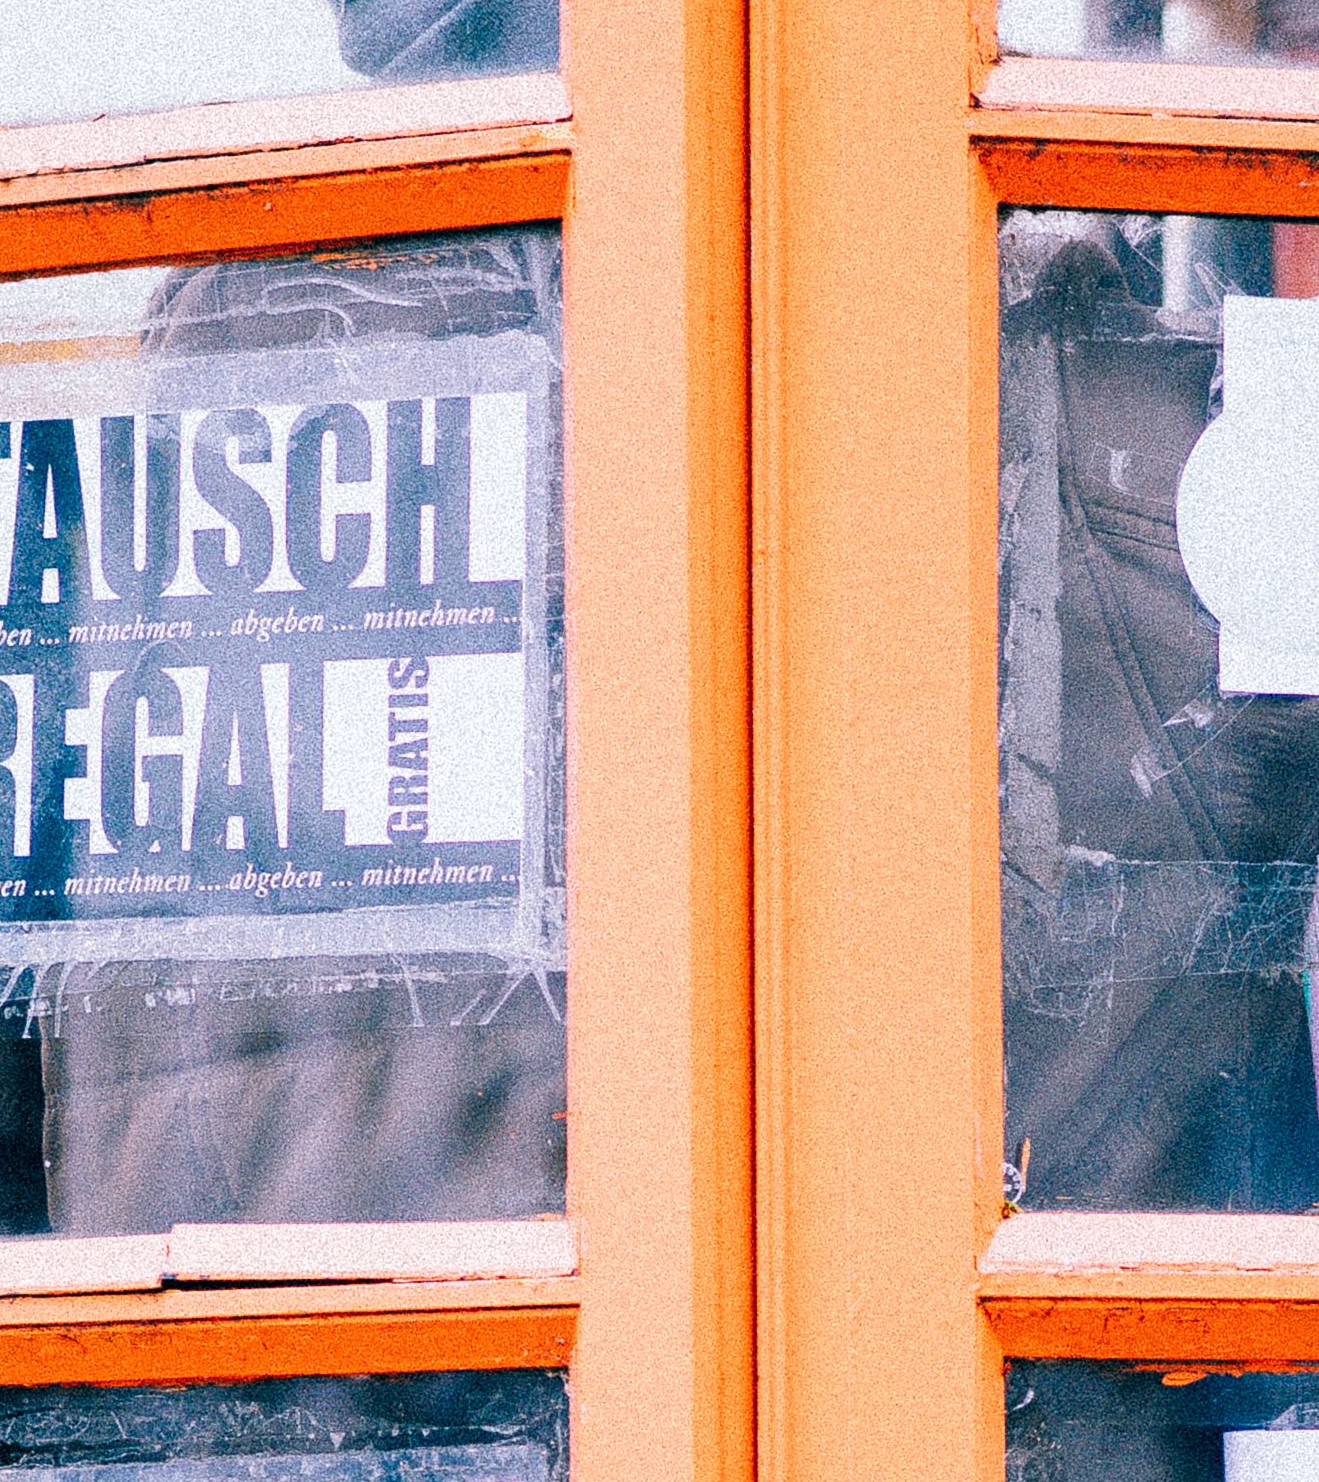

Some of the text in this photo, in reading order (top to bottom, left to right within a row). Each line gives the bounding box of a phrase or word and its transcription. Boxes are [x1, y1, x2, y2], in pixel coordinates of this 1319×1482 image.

[68, 614, 194, 644] mitnehmen
[230, 606, 325, 643] abgeben
[362, 599, 496, 631] mitnehmen
[385, 656, 431, 843] GRATIS
[63, 866, 192, 896] mitnehmen
[228, 861, 323, 897] abgeben
[361, 856, 494, 887] mitnehmen
